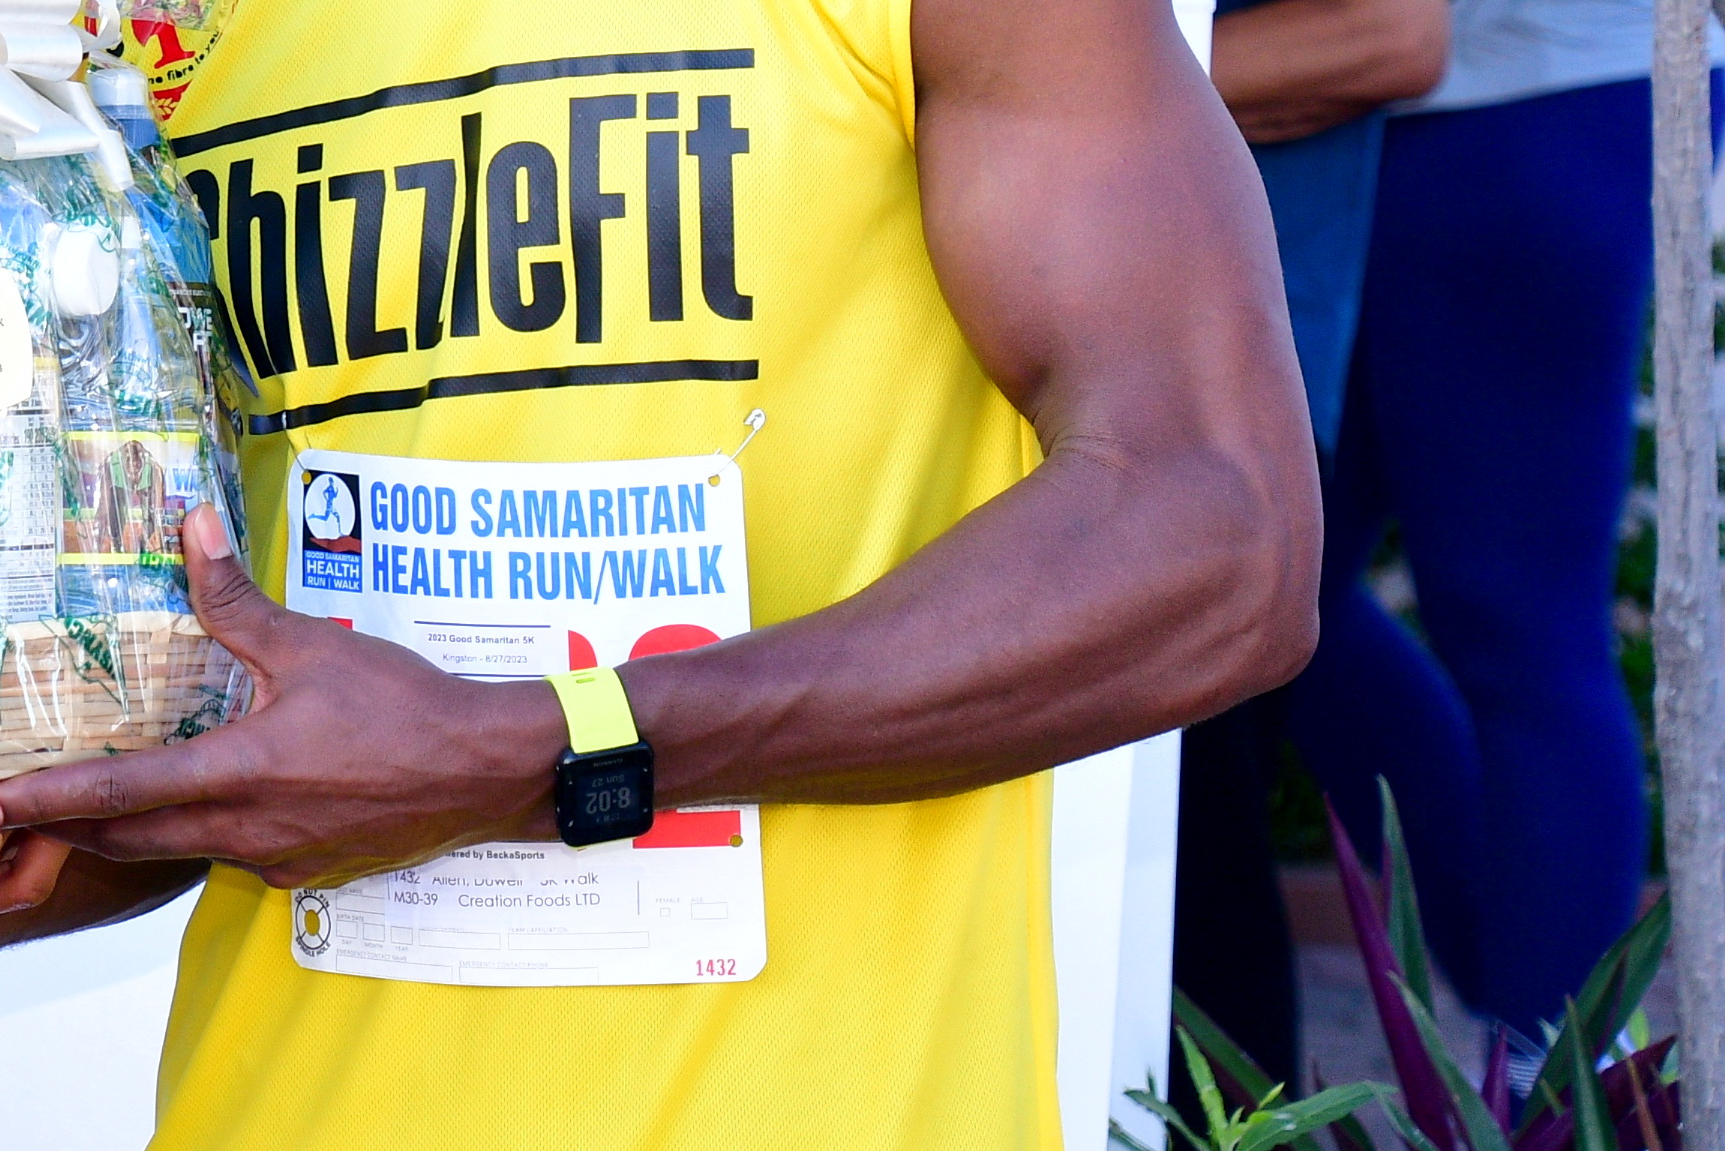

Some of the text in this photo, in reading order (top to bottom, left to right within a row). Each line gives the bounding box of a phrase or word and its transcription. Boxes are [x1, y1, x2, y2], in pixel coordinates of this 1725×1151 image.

[370, 481, 706, 538] GOOD SAMARITAN
[306, 551, 360, 563] GOOD SAMARITAN
[306, 559, 360, 579] HEALTH
[372, 542, 726, 605] HEALTH RUN/WALK
[307, 575, 360, 590] RUN WALK
[428, 633, 535, 644] 2023 Good Samaritan 5K
[442, 653, 477, 664] Kingston
[485, 654, 528, 664] 8/27/2023
[592, 774, 625, 788] Sun 27
[585, 786, 631, 815] 8:02
[473, 850, 484, 861] by
[486, 849, 545, 860] BeckaSports
[394, 892, 601, 908] M30-39 Creation Foods LTD
[695, 958, 737, 977] 1432
